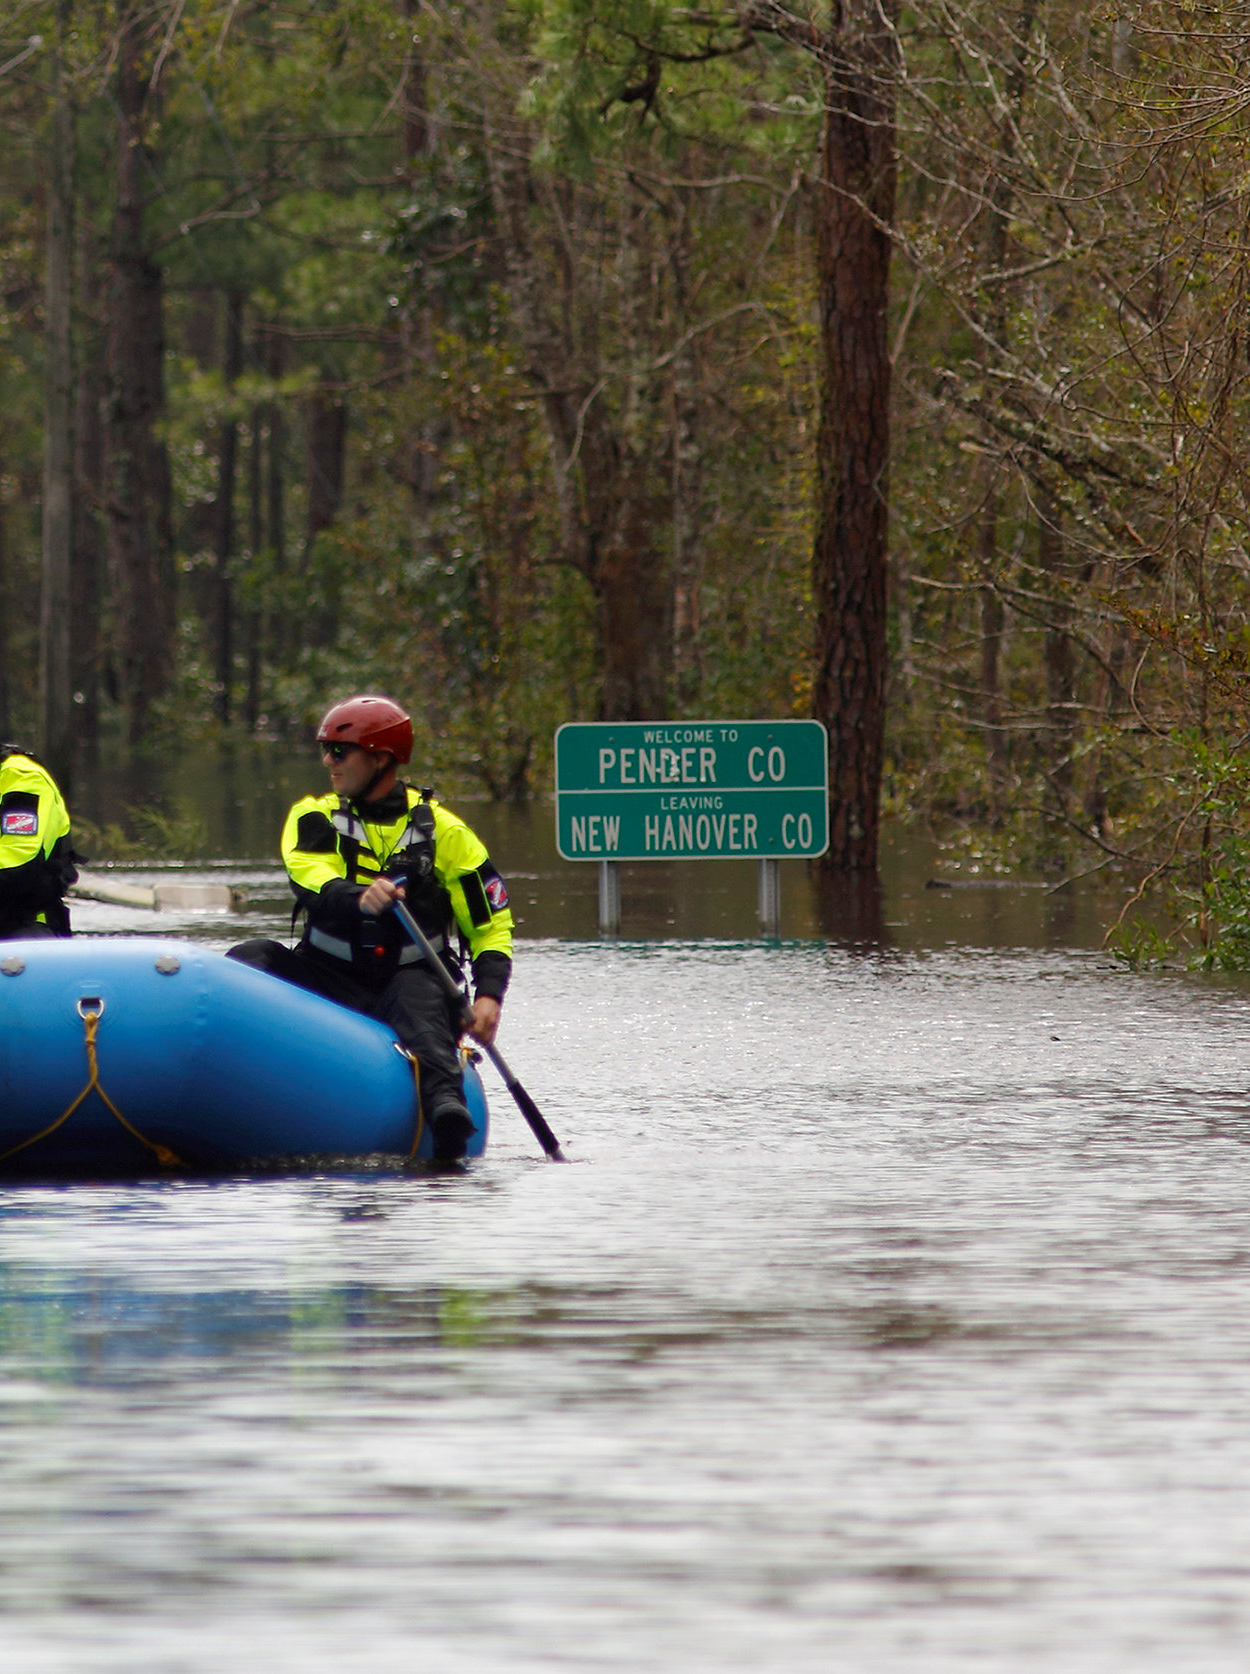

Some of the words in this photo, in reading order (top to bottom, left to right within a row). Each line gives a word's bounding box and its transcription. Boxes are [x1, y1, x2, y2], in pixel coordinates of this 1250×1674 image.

[643, 730, 714, 743] WELCOME
[720, 729, 739, 742] TO
[599, 747, 716, 783] PENDER
[748, 746, 786, 782] CO
[660, 796, 723, 810] LEAVING
[571, 815, 620, 852] NEW
[645, 813, 758, 851] HANOVER
[781, 813, 812, 849] CO
